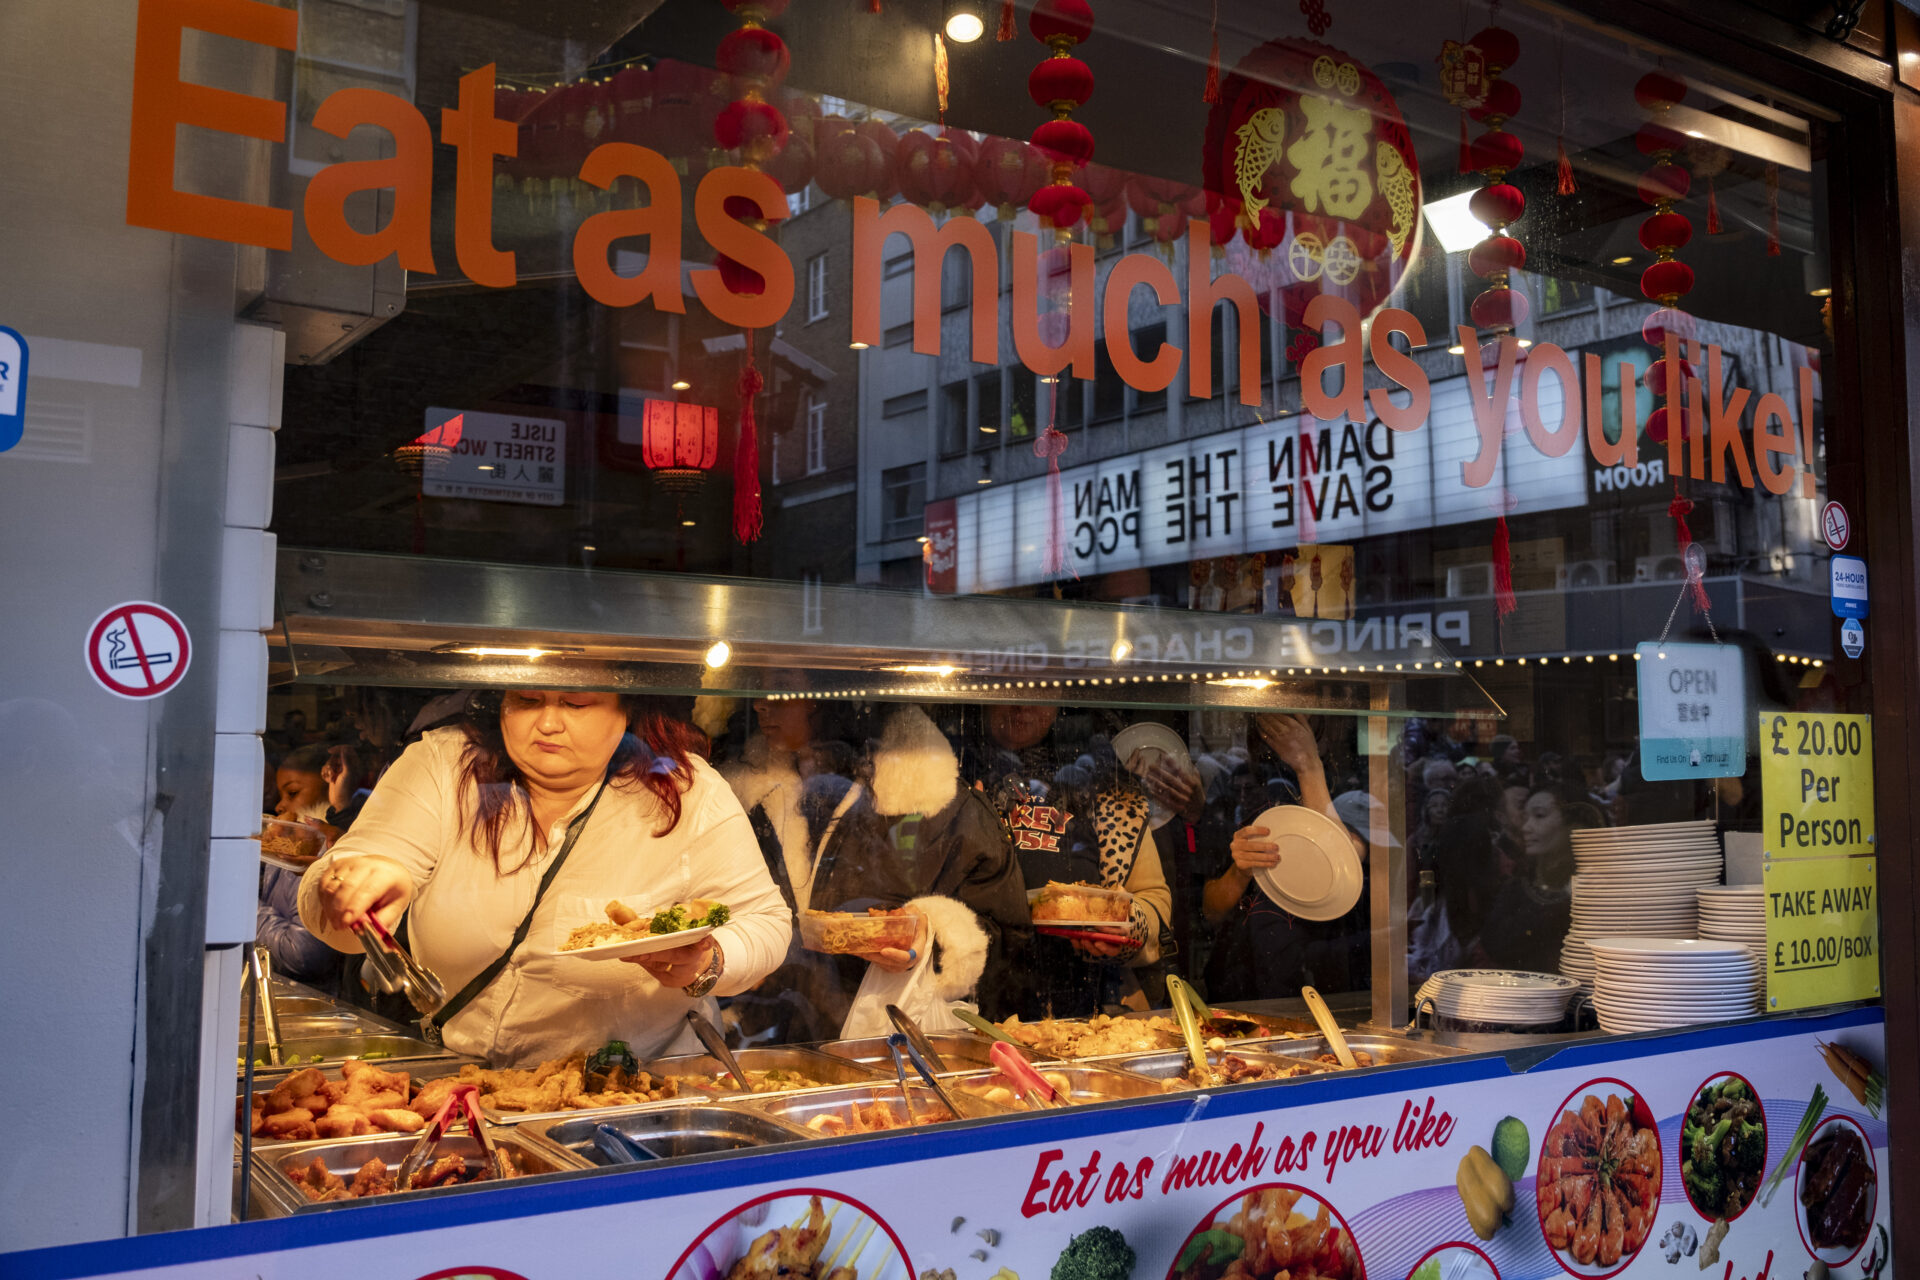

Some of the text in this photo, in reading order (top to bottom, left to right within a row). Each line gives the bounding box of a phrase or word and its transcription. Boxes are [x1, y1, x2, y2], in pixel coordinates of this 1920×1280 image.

[126, 0, 1817, 499] Eat as much as you like!
[1835, 571, 1865, 585] 24-HOUR
[1669, 668, 1718, 694] OPEN
[1771, 715, 1861, 756] £ 20.00
[1801, 768, 1840, 803] Per
[1780, 812, 1862, 848] Person
[1769, 885, 1872, 918] TAKE AWAY
[1774, 936, 1872, 967] £ 10.00/BOX
[1021, 1096, 1458, 1218] Eat as much as you like
